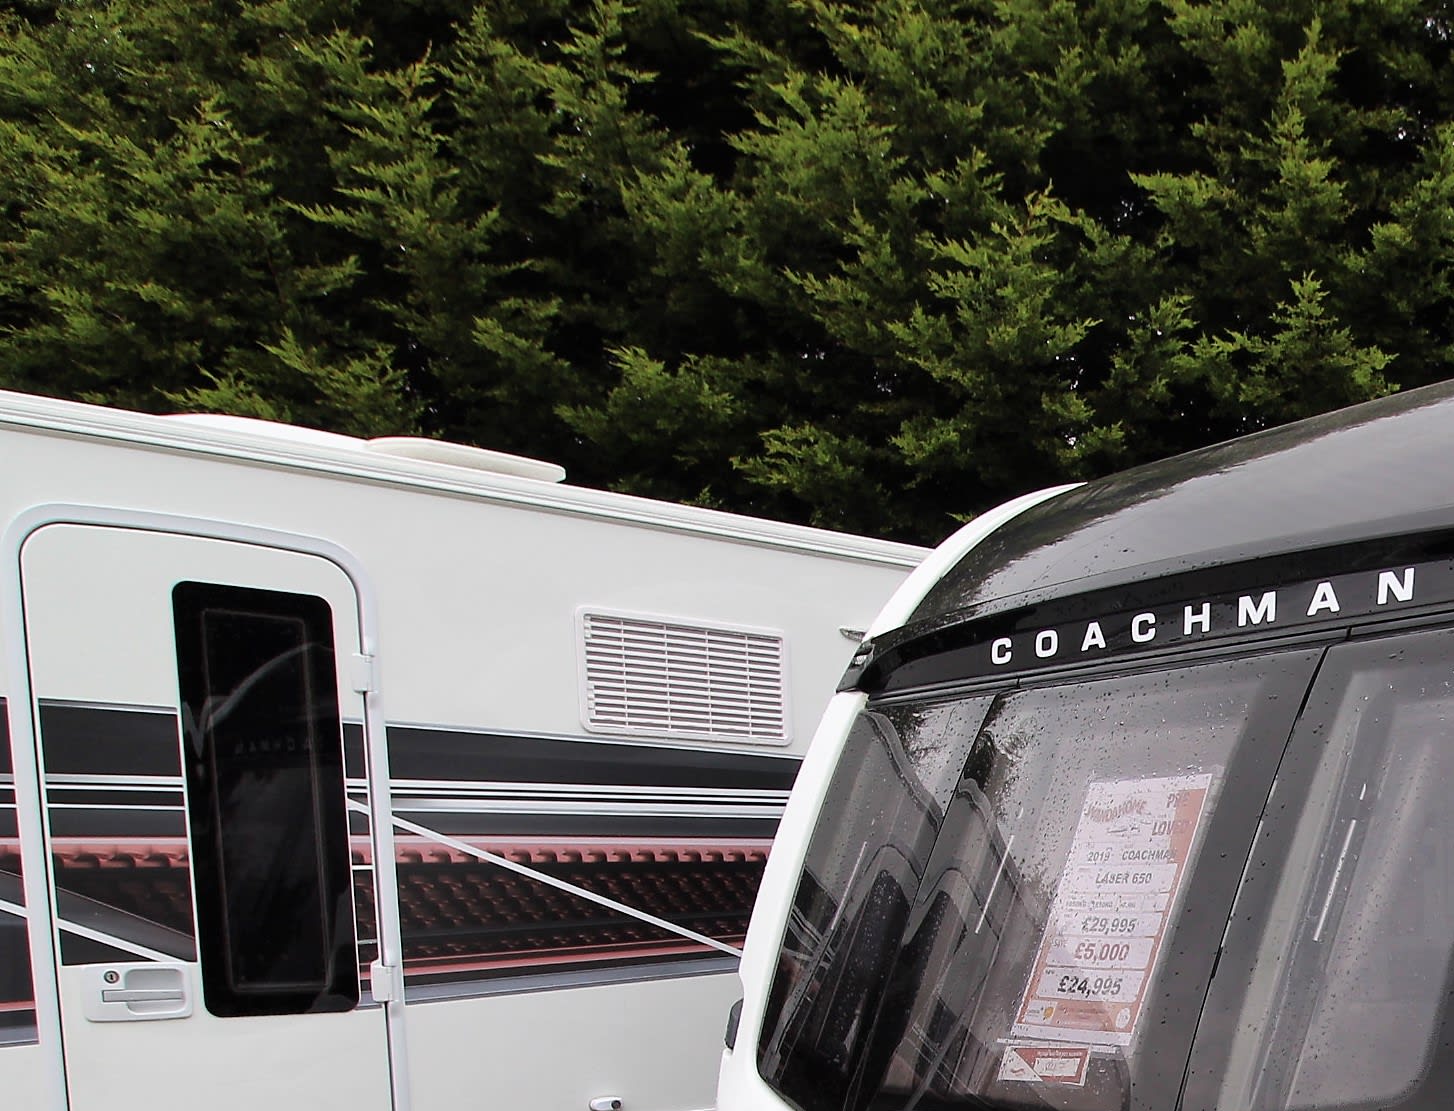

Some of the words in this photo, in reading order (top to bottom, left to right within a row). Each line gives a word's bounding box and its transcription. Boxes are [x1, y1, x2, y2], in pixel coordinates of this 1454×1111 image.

[990, 566, 1415, 666] COACHMAN
[1095, 872, 1129, 885] LASER
[1131, 872, 1152, 884] 650
[1080, 917, 1138, 935] £29,995
[1074, 942, 1130, 963] £5,000
[1057, 975, 1122, 998] £24,995
